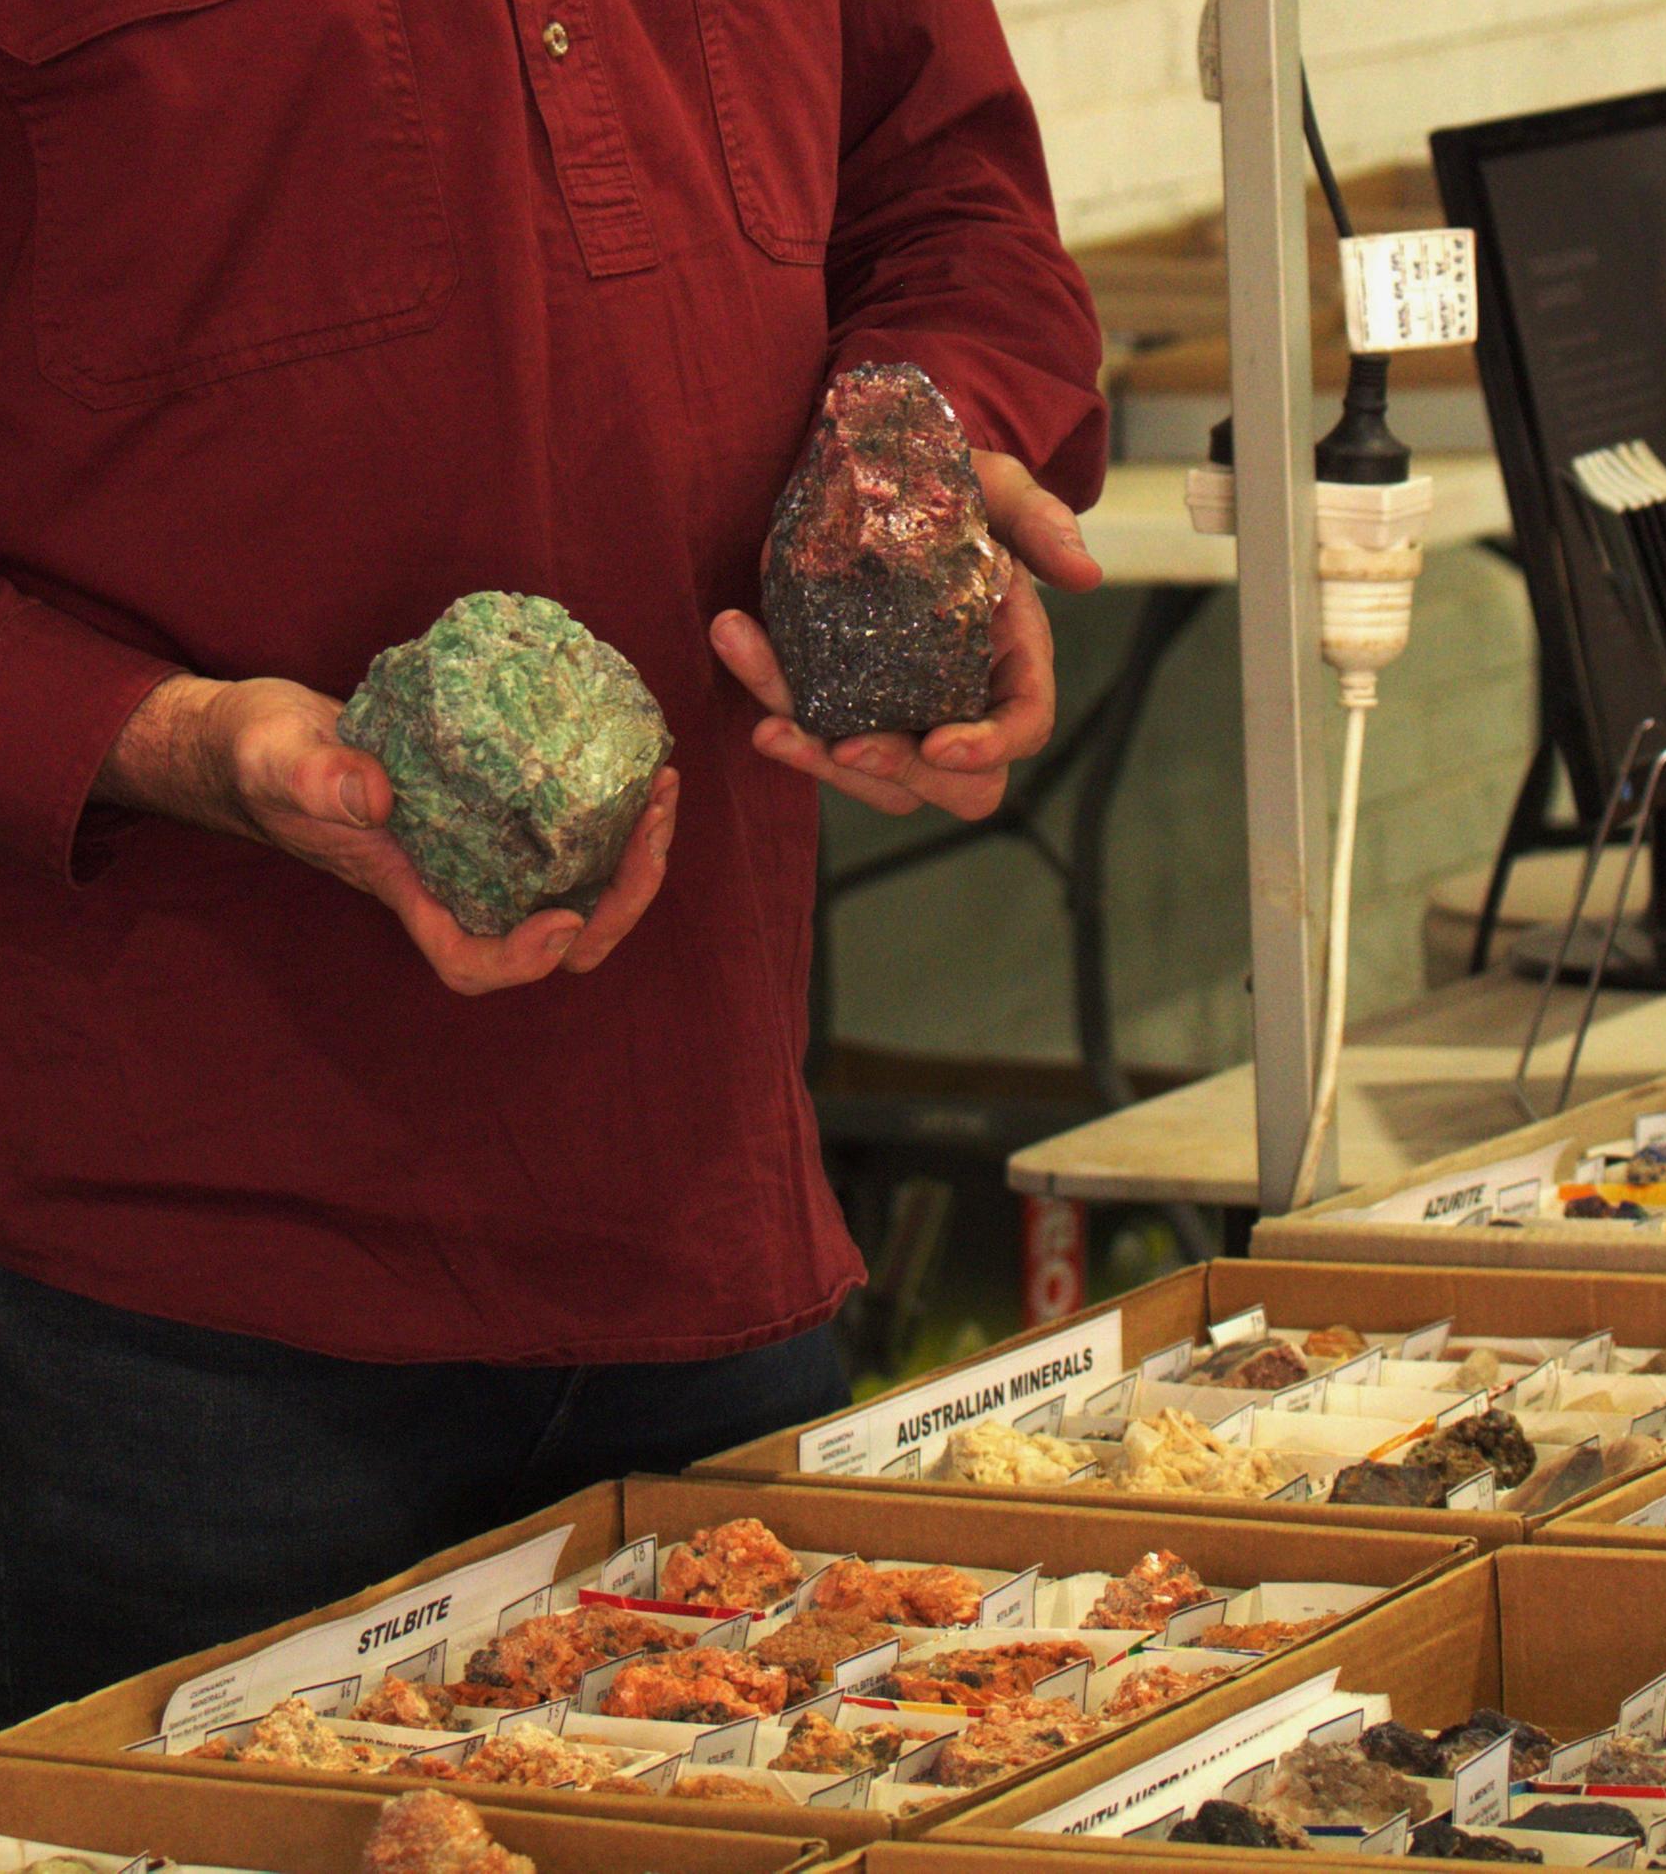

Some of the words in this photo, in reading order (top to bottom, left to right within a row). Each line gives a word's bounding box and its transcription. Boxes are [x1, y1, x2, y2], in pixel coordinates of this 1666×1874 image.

[1423, 1184, 1486, 1220] AZURITE
[897, 1383, 1005, 1447] AUSTRALIAN
[1010, 1347, 1093, 1402] MINERALS
[357, 1594, 452, 1655] STILBITE
